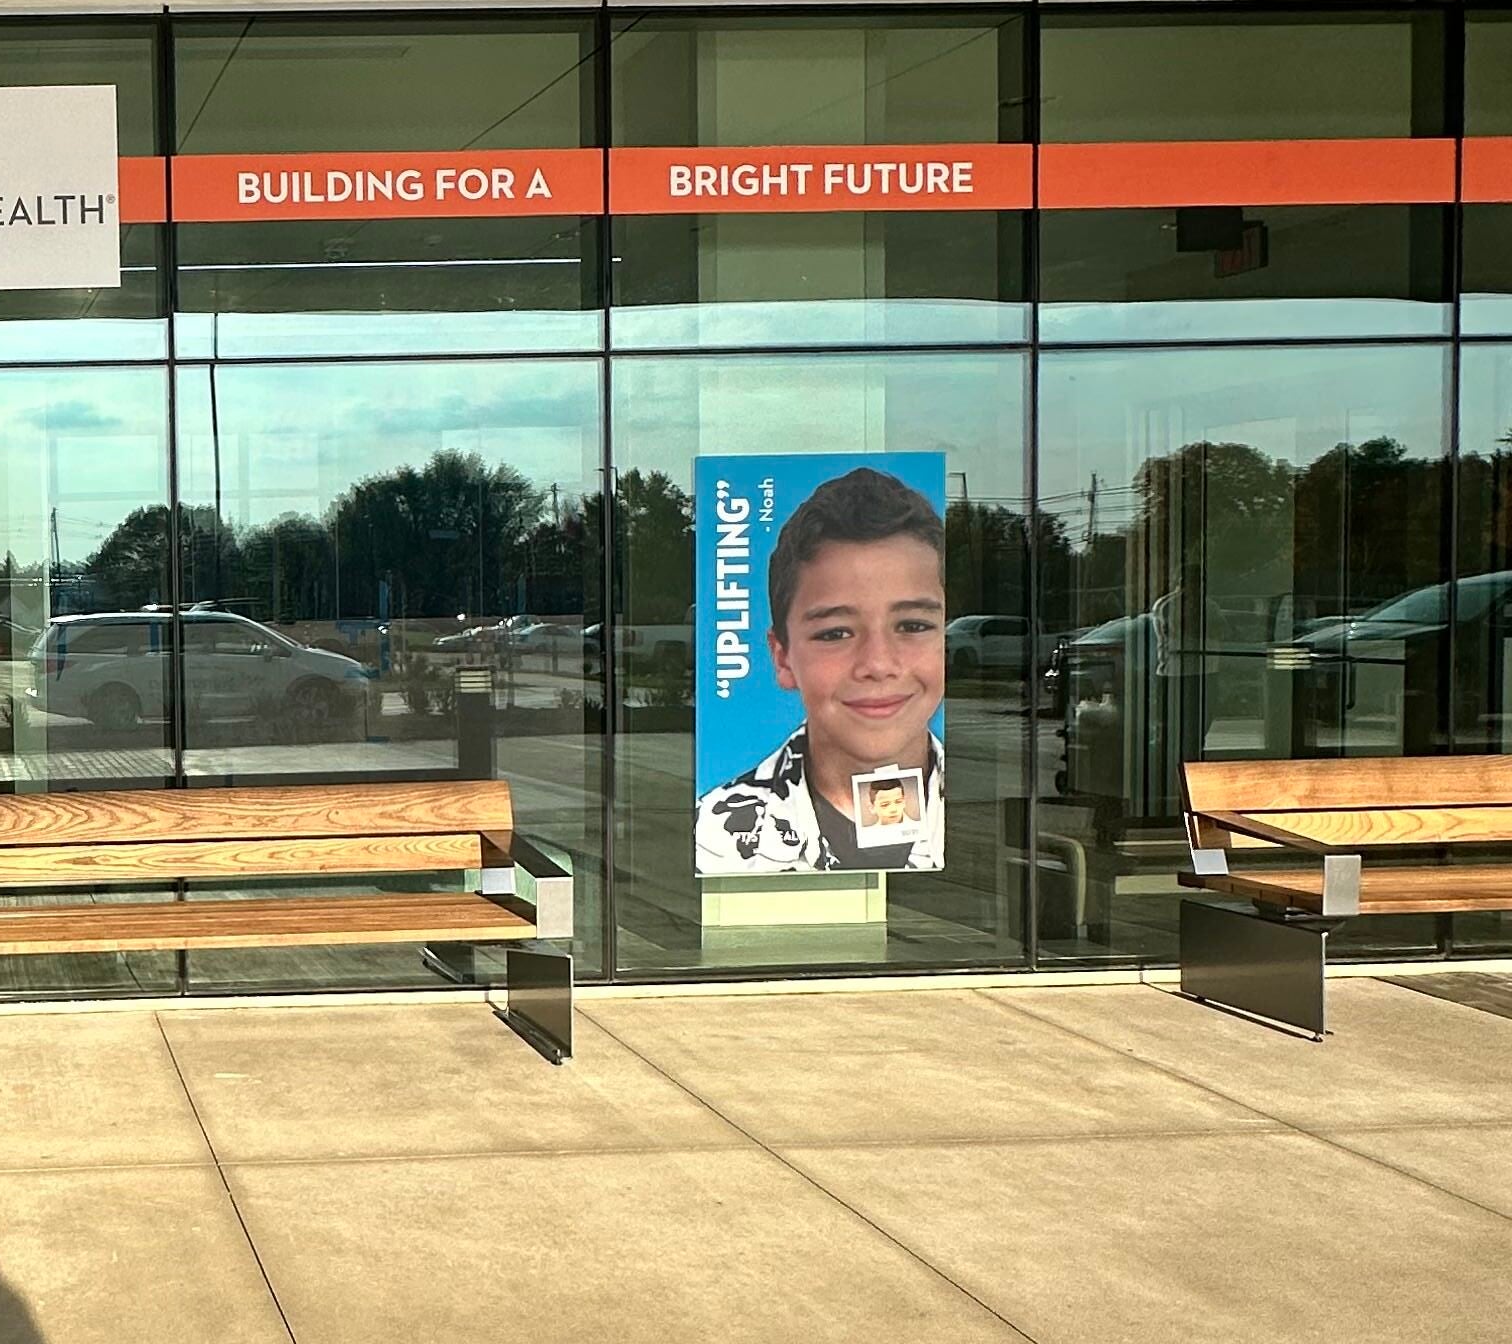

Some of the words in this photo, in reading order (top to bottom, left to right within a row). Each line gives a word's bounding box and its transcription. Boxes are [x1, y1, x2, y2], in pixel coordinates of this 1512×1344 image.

[238, 168, 424, 204] BUILDING
[435, 169, 516, 201] FOR
[526, 167, 553, 199] A
[669, 163, 813, 197] BRIGHT
[823, 161, 974, 194] FUTURE
[757, 477, 774, 523] Noah
